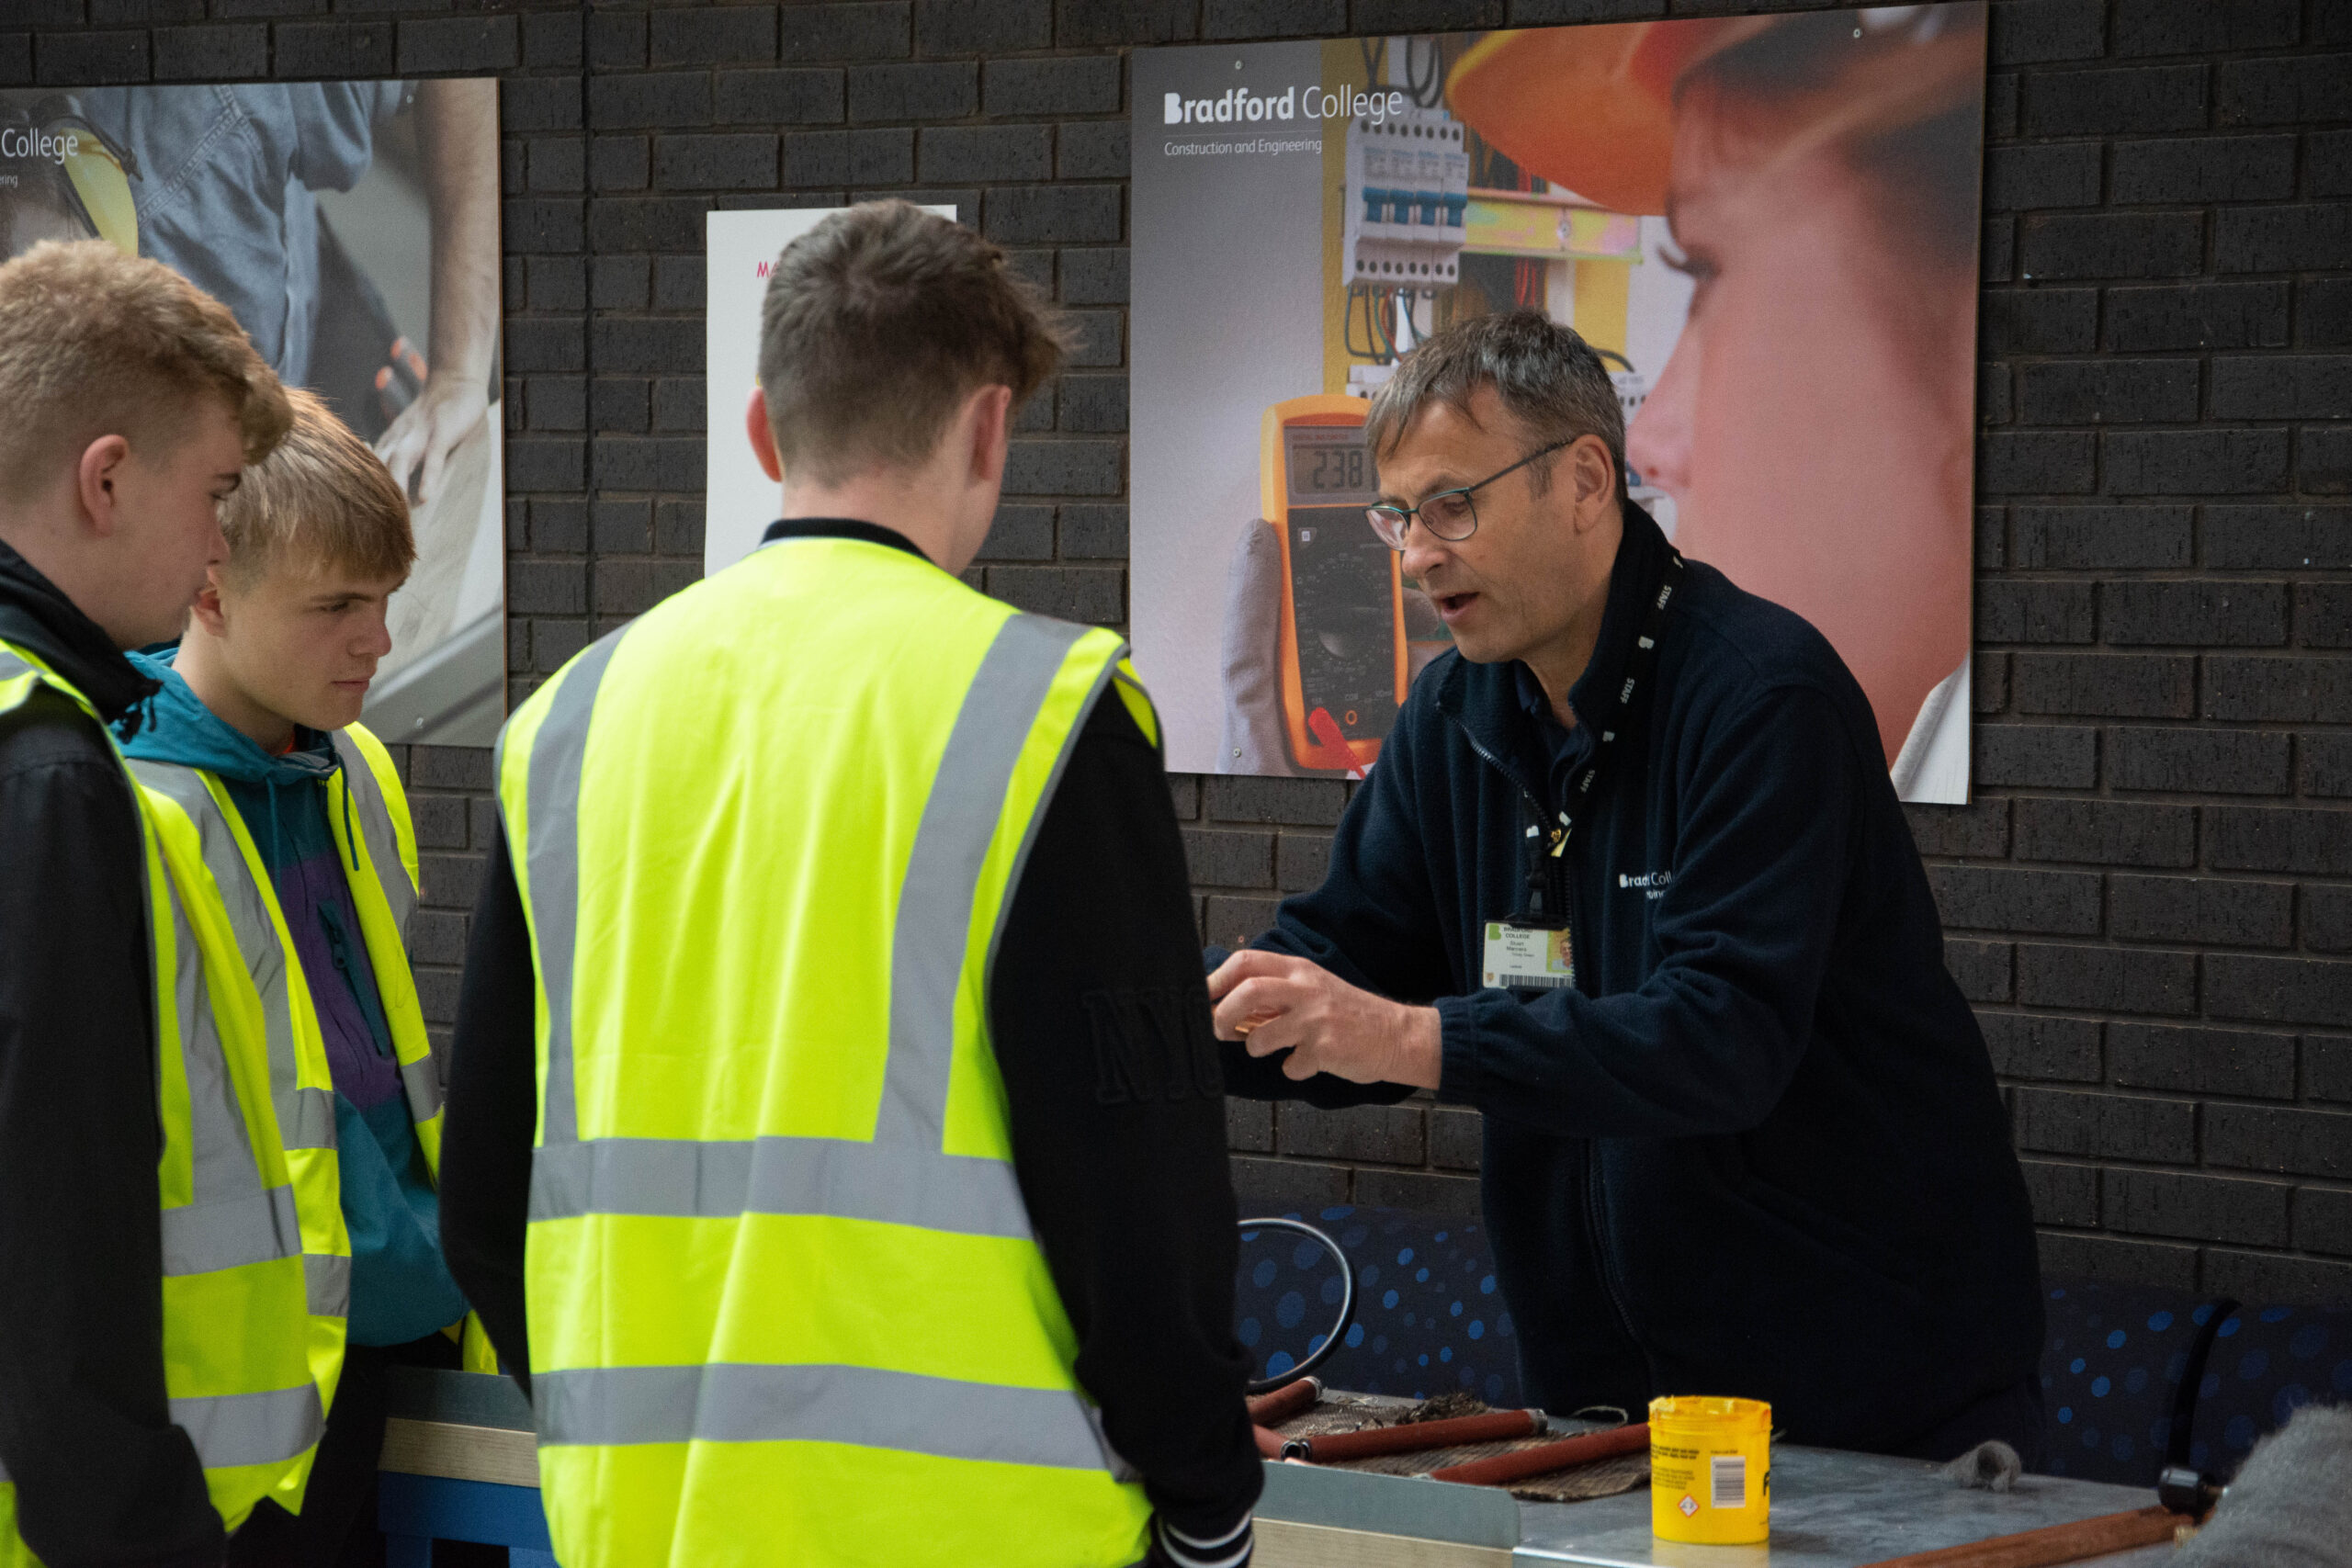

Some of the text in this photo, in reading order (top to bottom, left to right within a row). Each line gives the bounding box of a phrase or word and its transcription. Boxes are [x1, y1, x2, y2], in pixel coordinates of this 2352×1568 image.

[1164, 84, 1403, 126] Bradford College
[1, 127, 79, 165] College
[1164, 138, 1322, 156] Construction and Engineering
[1657, 585, 1672, 610] STAFF
[1620, 678, 1634, 704] STAFF
[1580, 770, 1595, 793] STAFF
[1651, 870, 1672, 886] Coll
